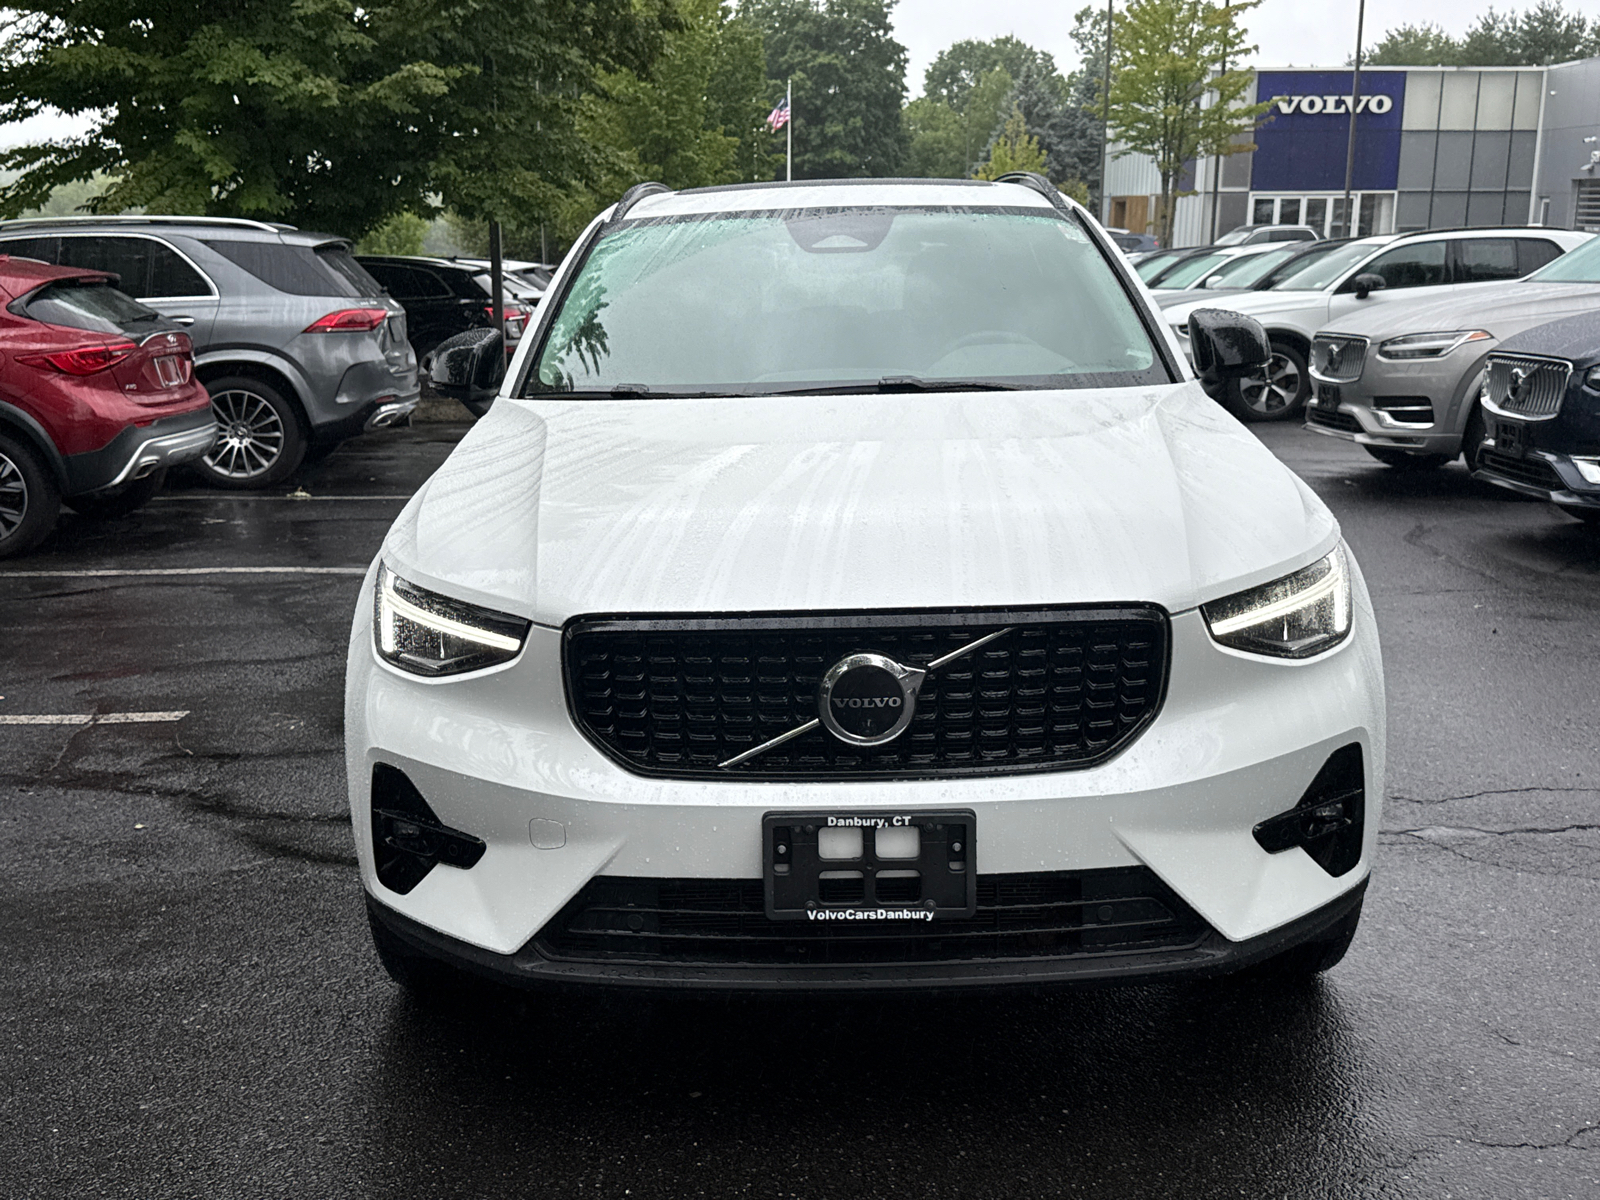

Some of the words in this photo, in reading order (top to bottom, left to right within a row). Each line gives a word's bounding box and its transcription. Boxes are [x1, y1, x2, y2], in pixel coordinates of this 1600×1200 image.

[1272, 95, 1393, 115] VOLVO
[832, 696, 902, 709] VOLVO
[827, 816, 889, 829] Danbury,
[892, 815, 912, 827] CT
[807, 909, 935, 921] VolvoCarsDanbury
